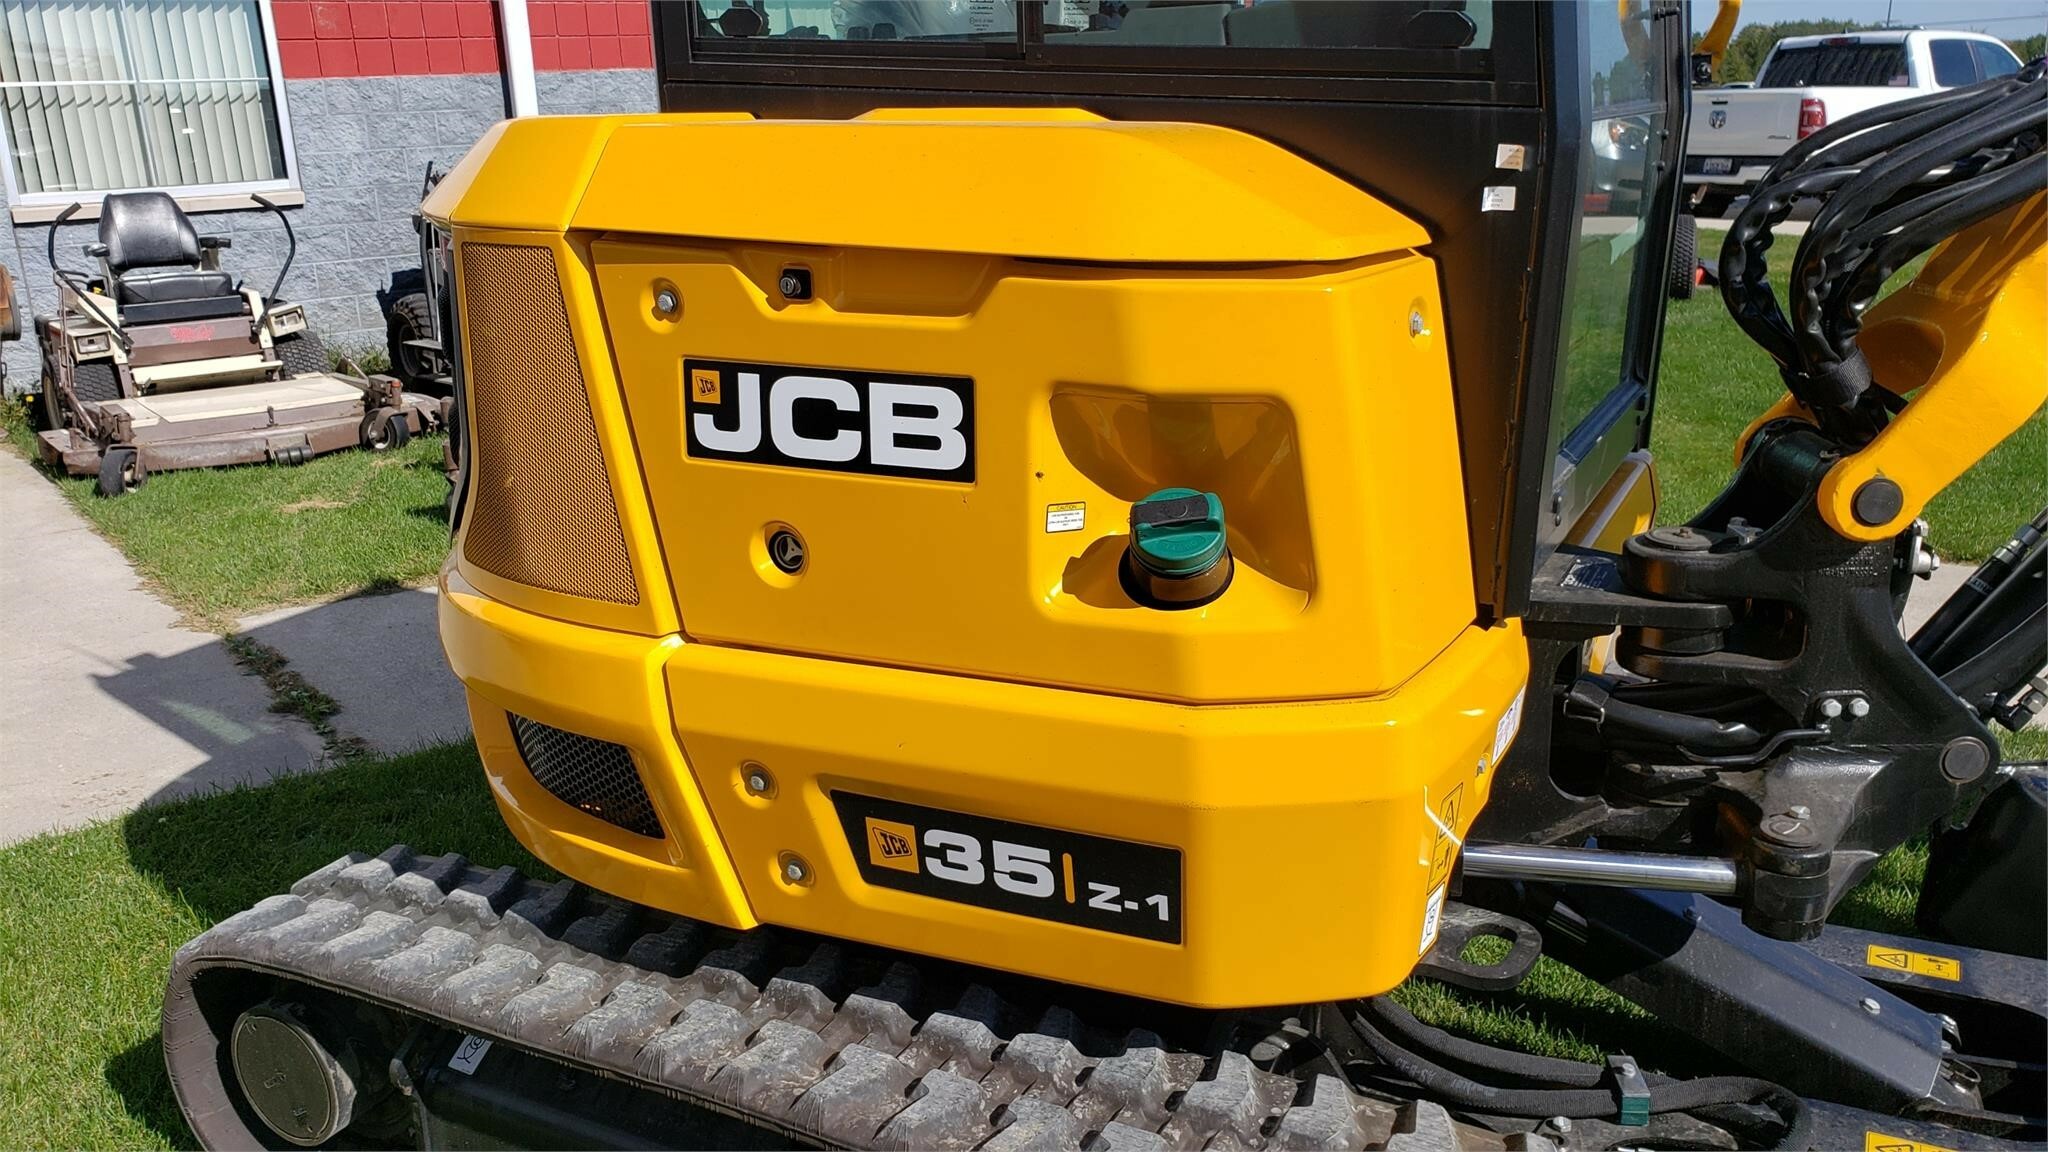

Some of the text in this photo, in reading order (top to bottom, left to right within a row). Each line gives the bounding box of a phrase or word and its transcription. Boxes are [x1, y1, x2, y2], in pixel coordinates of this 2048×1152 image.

[700, 377, 717, 394] JCB
[693, 372, 967, 471] JCB
[880, 831, 910, 856] JCB
[924, 829, 1169, 921] 35 Z-1
